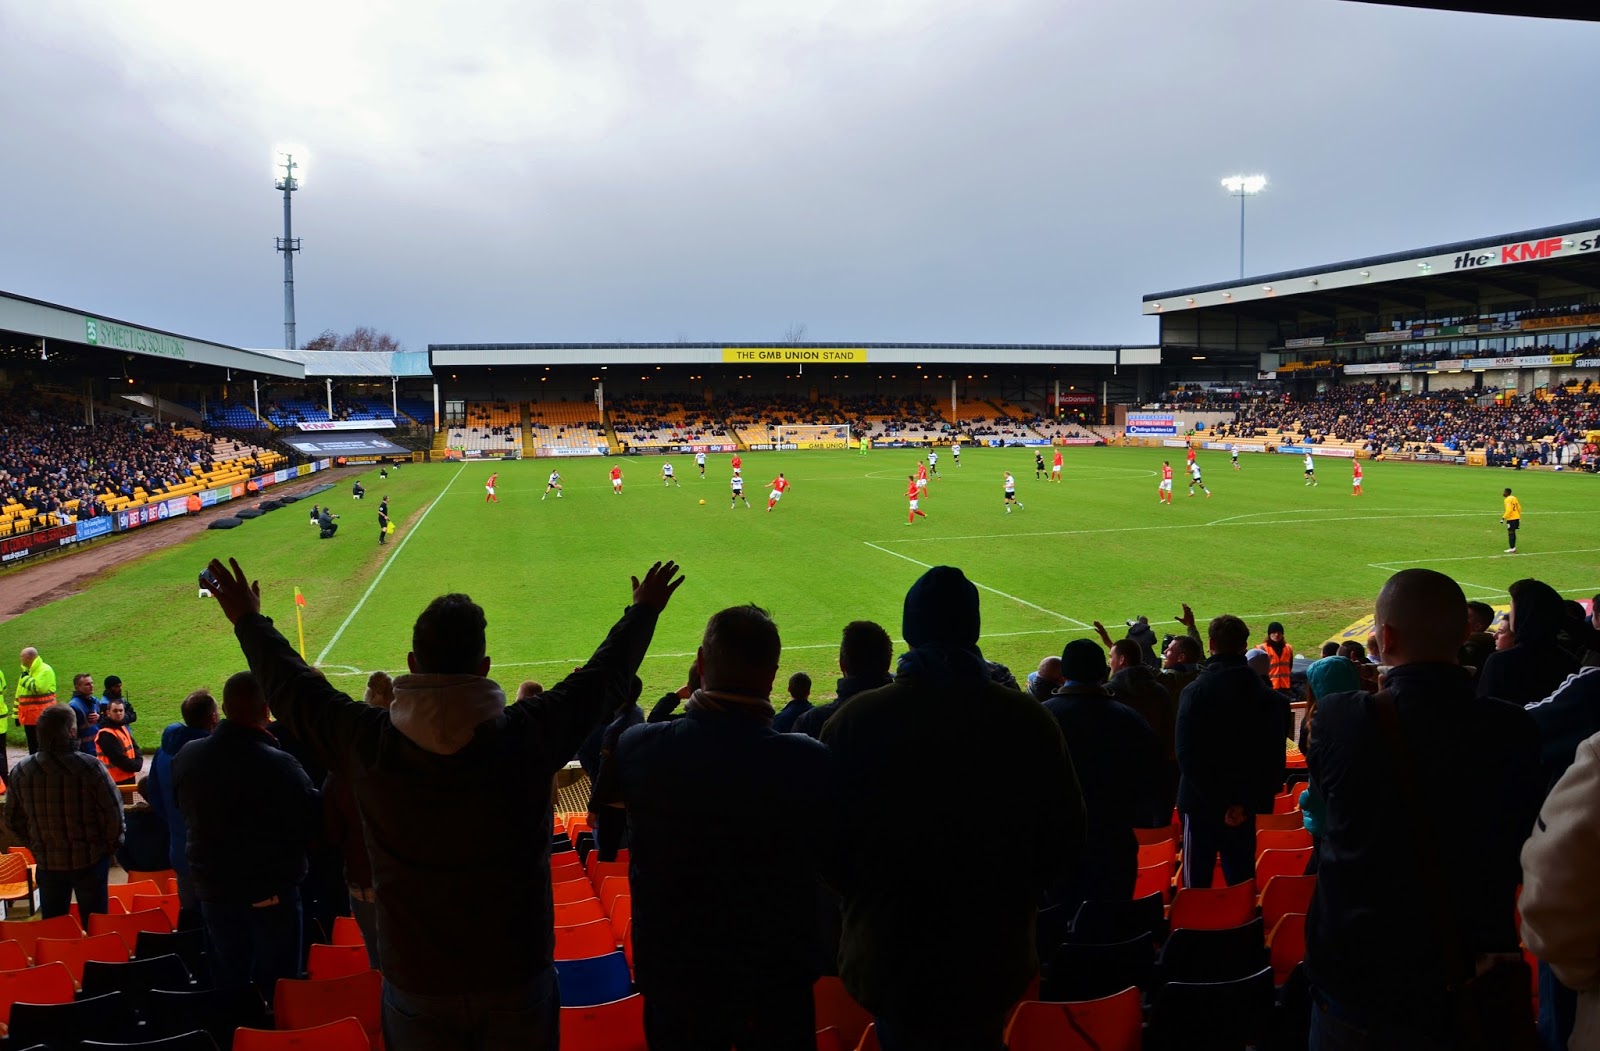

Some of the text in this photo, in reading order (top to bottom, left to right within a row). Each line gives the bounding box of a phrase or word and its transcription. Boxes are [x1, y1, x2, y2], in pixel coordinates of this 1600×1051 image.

[1454, 253, 1490, 269] the
[1501, 237, 1563, 264] KMF
[100, 323, 185, 357] SYNECTICS SOLUTIONS
[736, 351, 854, 360] THE GMB UNION STAND
[680, 445, 692, 453] sky
[710, 444, 721, 452] sky
[120, 513, 129, 529] sky
[129, 511, 139, 526] BET
[140, 508, 149, 523] sky
[148, 506, 158, 520] BET
